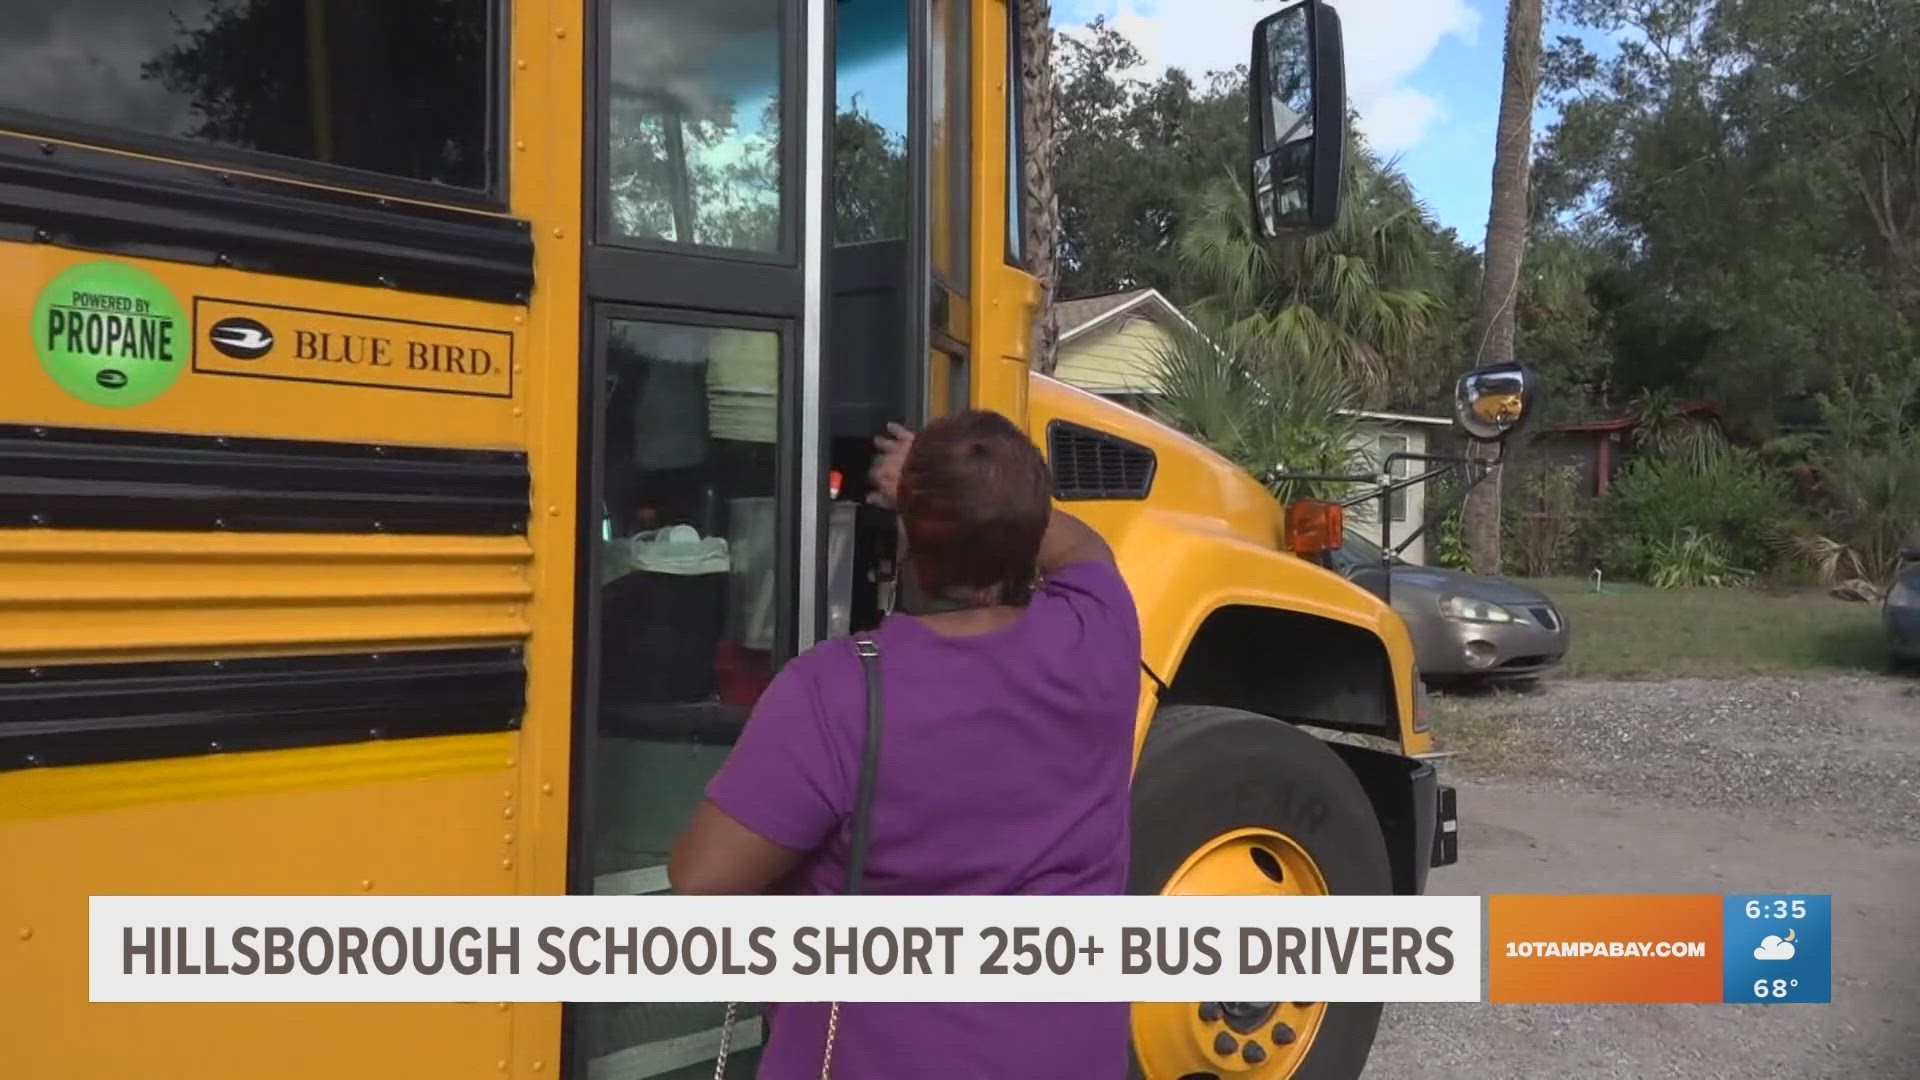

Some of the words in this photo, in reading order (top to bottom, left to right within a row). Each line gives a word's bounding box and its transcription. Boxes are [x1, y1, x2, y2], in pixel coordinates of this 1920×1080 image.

[72, 291, 132, 312] POWERED
[135, 297, 151, 313] BY
[48, 309, 173, 362] PROPANE
[293, 329, 393, 367] BLUE
